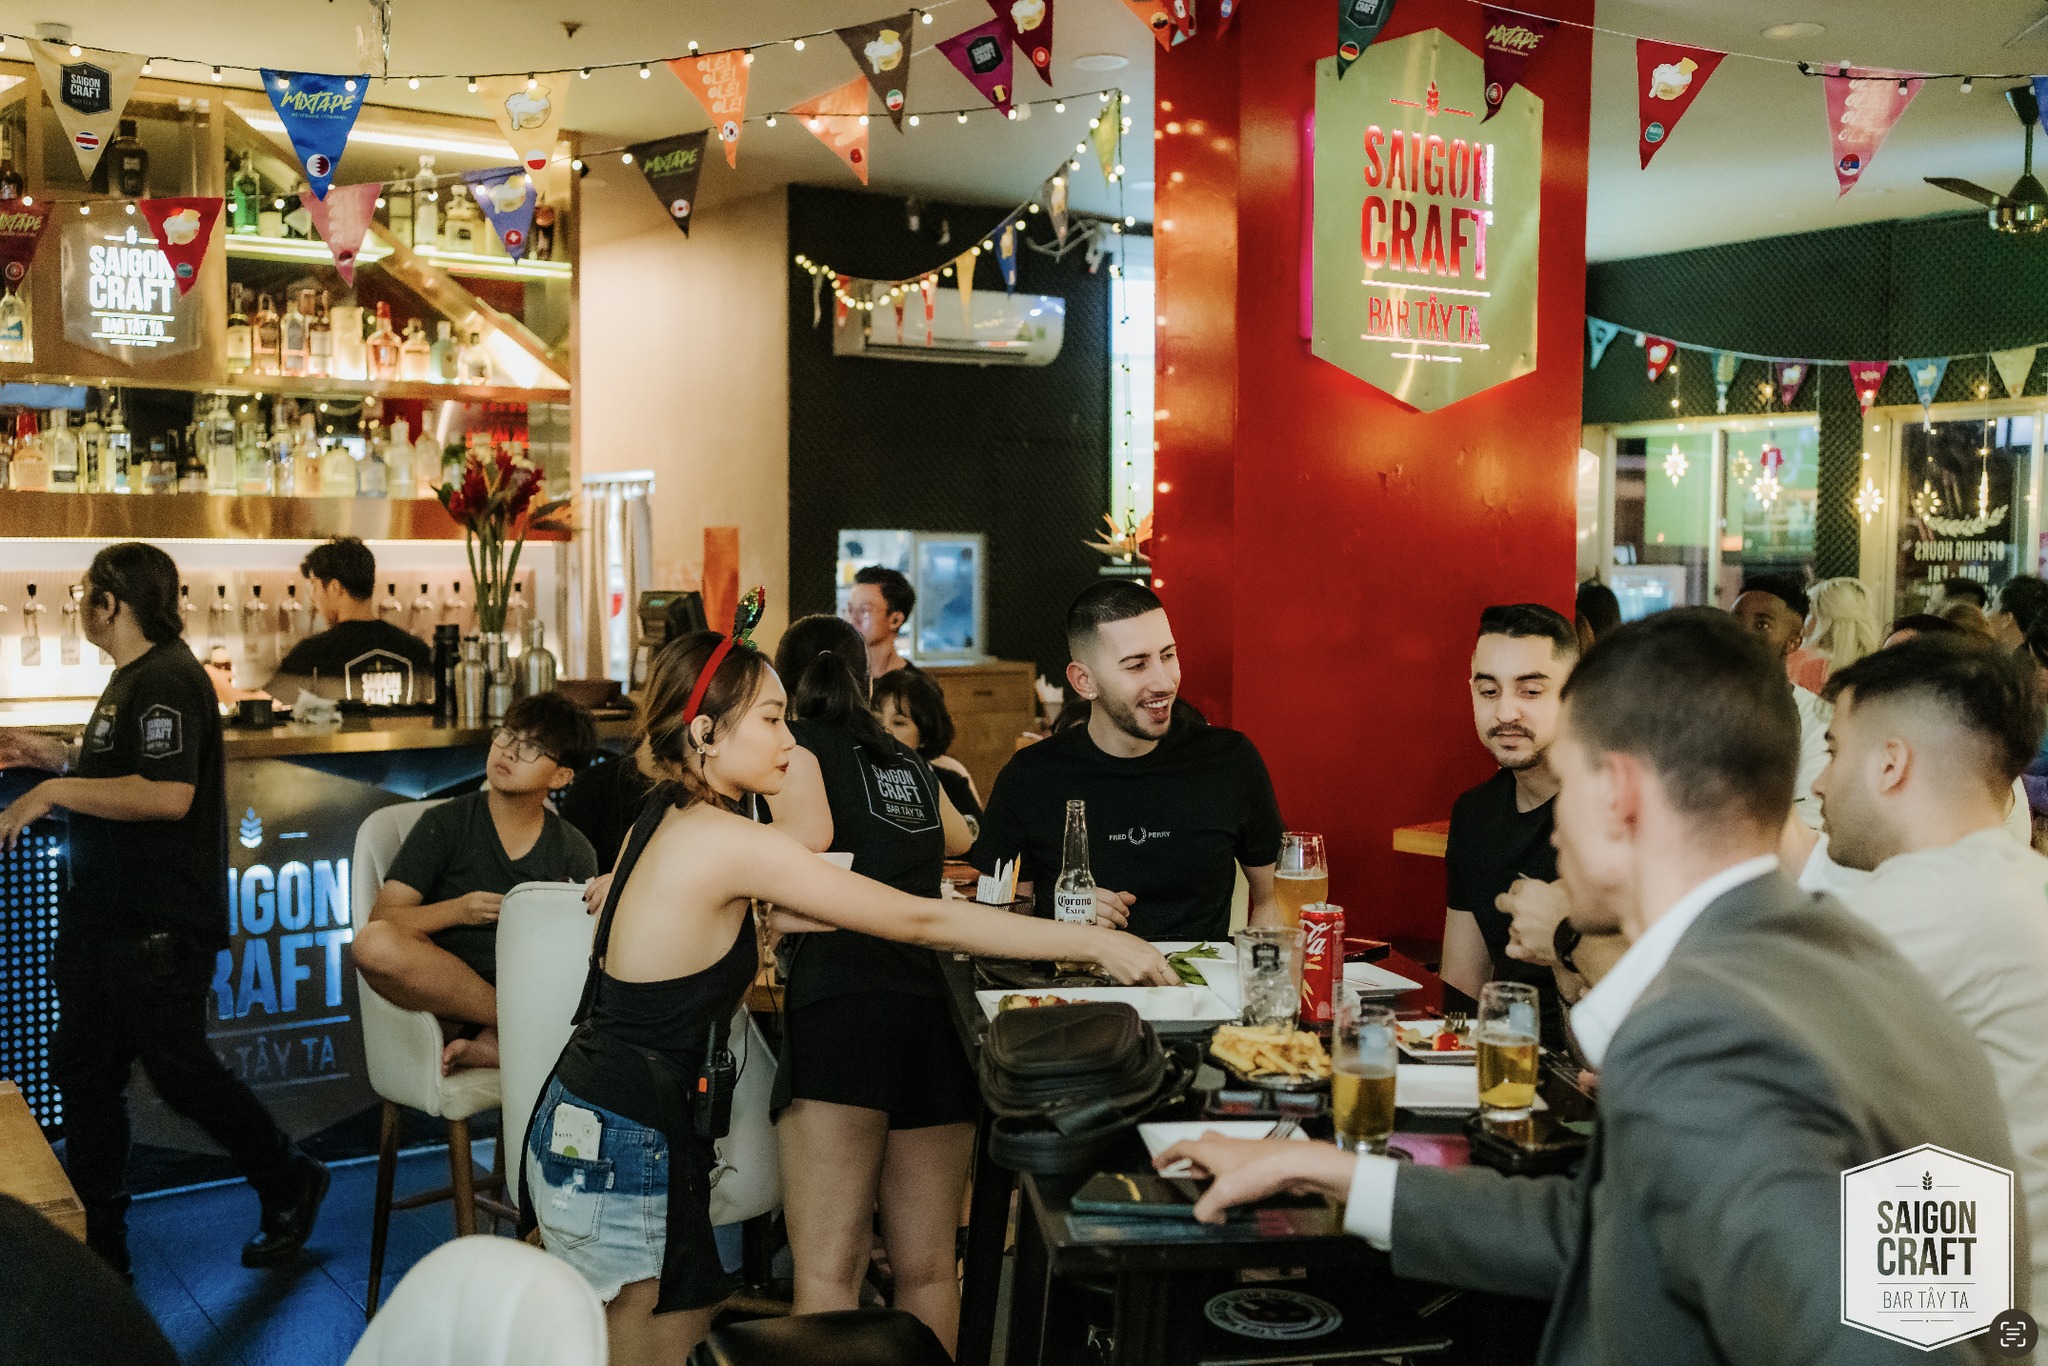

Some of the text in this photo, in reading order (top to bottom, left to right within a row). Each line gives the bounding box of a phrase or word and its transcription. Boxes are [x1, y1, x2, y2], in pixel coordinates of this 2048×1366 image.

[70, 73, 101, 88] SAIGON
[70, 83, 101, 99] CRAFT
[280, 90, 356, 115] MIXTAPE
[1363, 124, 1495, 206] SAIGON
[1360, 195, 1494, 281] CRAFT
[88, 245, 175, 280] SAIGON
[88, 274, 176, 313] CRAFT
[1367, 291, 1482, 343] BAR TÂY TA
[871, 764, 917, 786] SAIGON
[877, 779, 922, 804] CRAFT
[885, 803, 901, 815] BAR
[1109, 831, 1170, 841] FRED PERRY
[227, 857, 351, 936] IGON
[300, 1034, 337, 1073] TA
